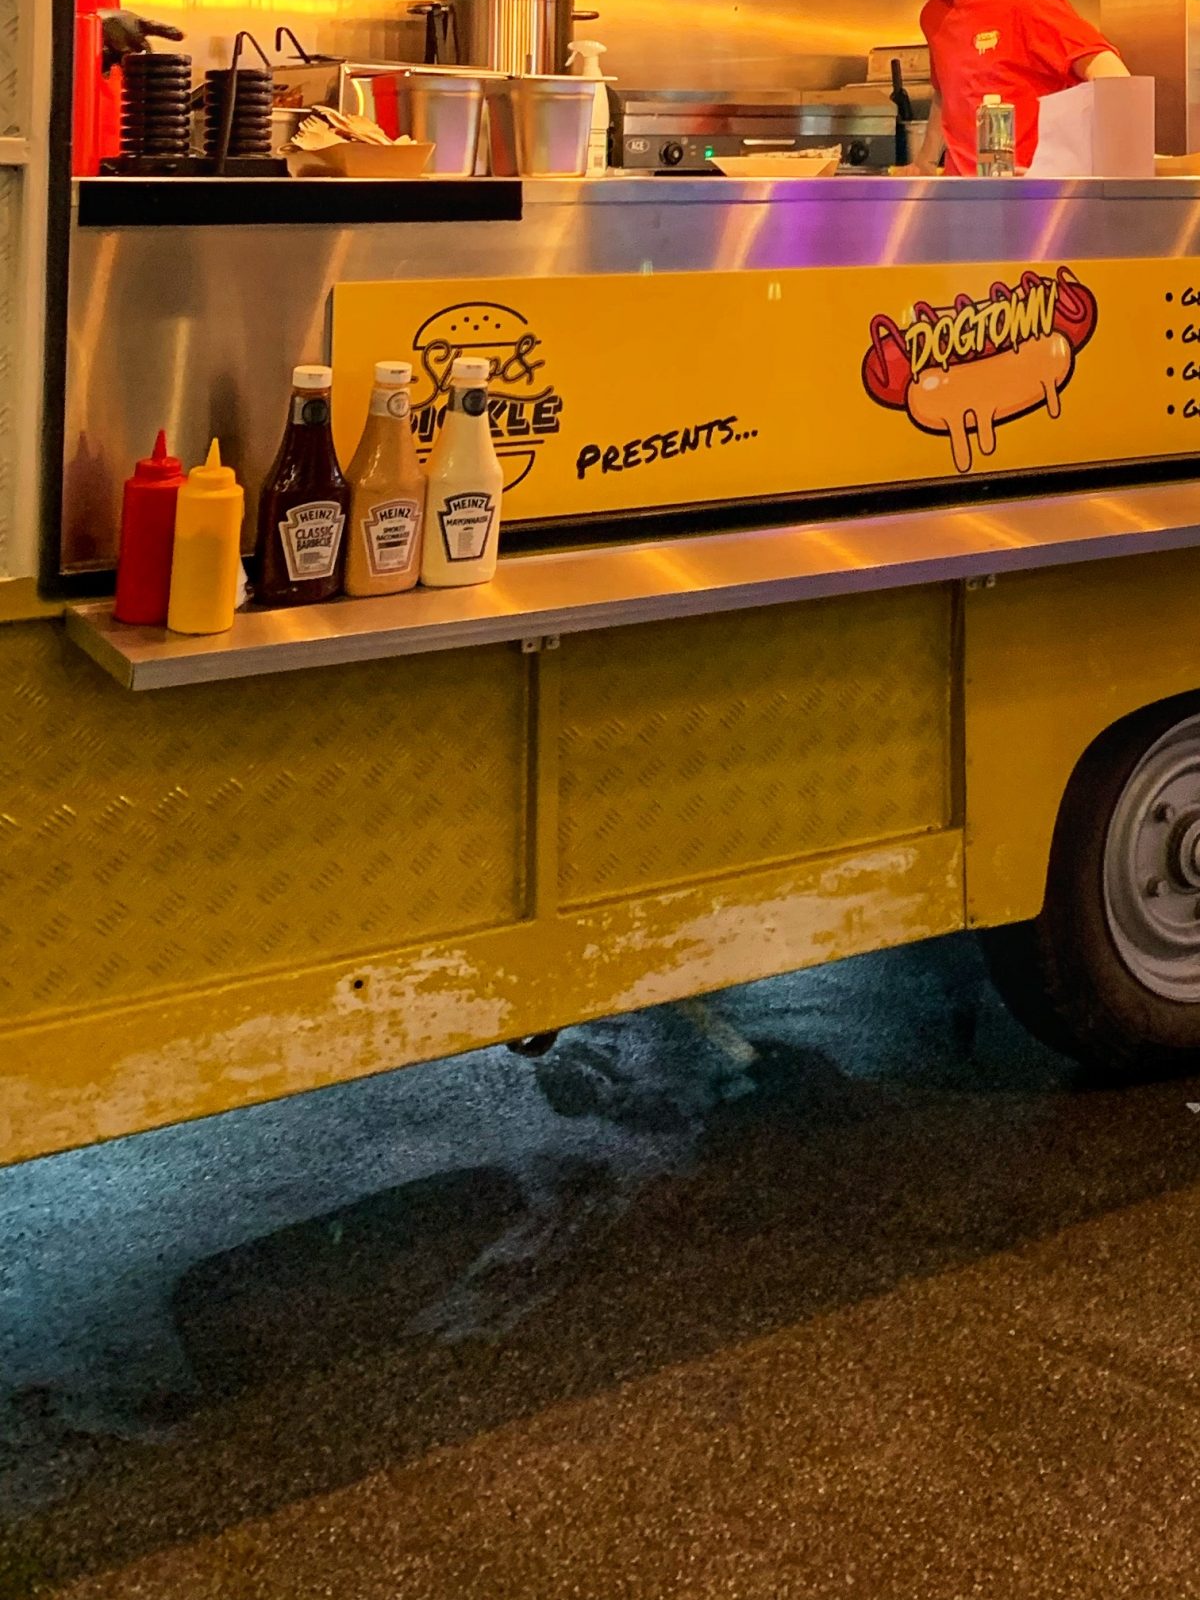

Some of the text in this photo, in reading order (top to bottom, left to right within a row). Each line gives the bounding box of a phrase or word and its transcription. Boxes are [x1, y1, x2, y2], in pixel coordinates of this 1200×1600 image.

[905, 279, 1059, 384] DOGTOWN
[411, 395, 563, 443] IKLE
[576, 416, 759, 480] PRESENTS...
[453, 499, 485, 511] HEINZ
[300, 510, 333, 522] HEINZ
[379, 508, 411, 522] HEINZ
[295, 525, 333, 539] CLASSIC
[296, 537, 332, 551] BARBECUE
